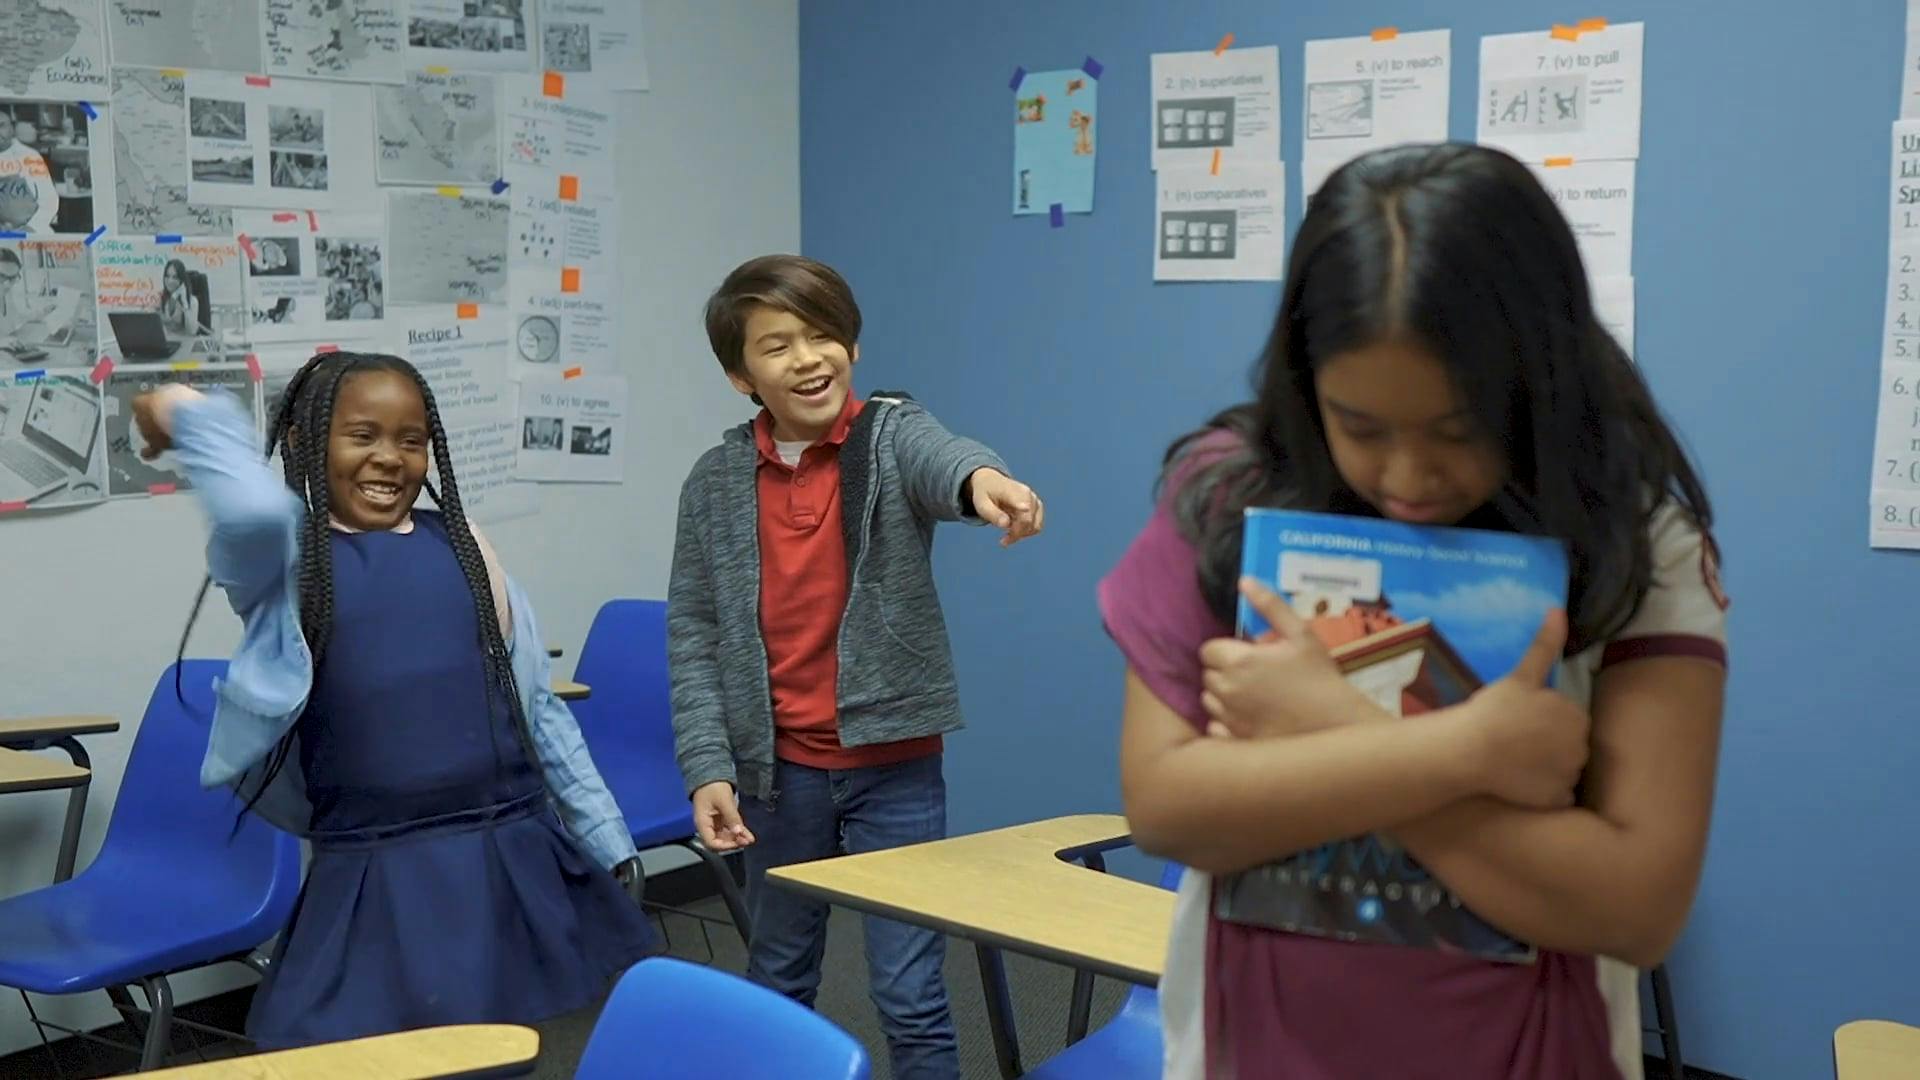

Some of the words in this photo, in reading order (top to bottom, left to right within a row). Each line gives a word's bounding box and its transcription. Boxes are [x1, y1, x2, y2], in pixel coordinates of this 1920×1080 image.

[1371, 59, 1389, 74] (v)
[1391, 58, 1404, 71] to
[1406, 55, 1443, 70] reach
[1554, 54, 1573, 71] (v)
[1577, 54, 1590, 67] to
[1594, 50, 1619, 68] pull
[1199, 75, 1264, 90] superlatives
[1193, 188, 1267, 202] comparatives
[1567, 189, 1580, 200] to
[1585, 187, 1628, 200] return
[1904, 211, 1919, 228] 1.
[1900, 255, 1916, 273] 2.
[1898, 283, 1914, 301] 3.
[1896, 311, 1912, 330] 4.
[408, 328, 451, 345] Recipe
[455, 325, 463, 340] 1
[1895, 338, 1912, 357] 5.
[1892, 376, 1909, 396] 6.
[571, 396, 581, 407] to
[583, 398, 610, 411] agree
[1886, 459, 1903, 477] 7.
[1884, 504, 1902, 523] 8.
[1279, 529, 1374, 553] CALIFORNIA
